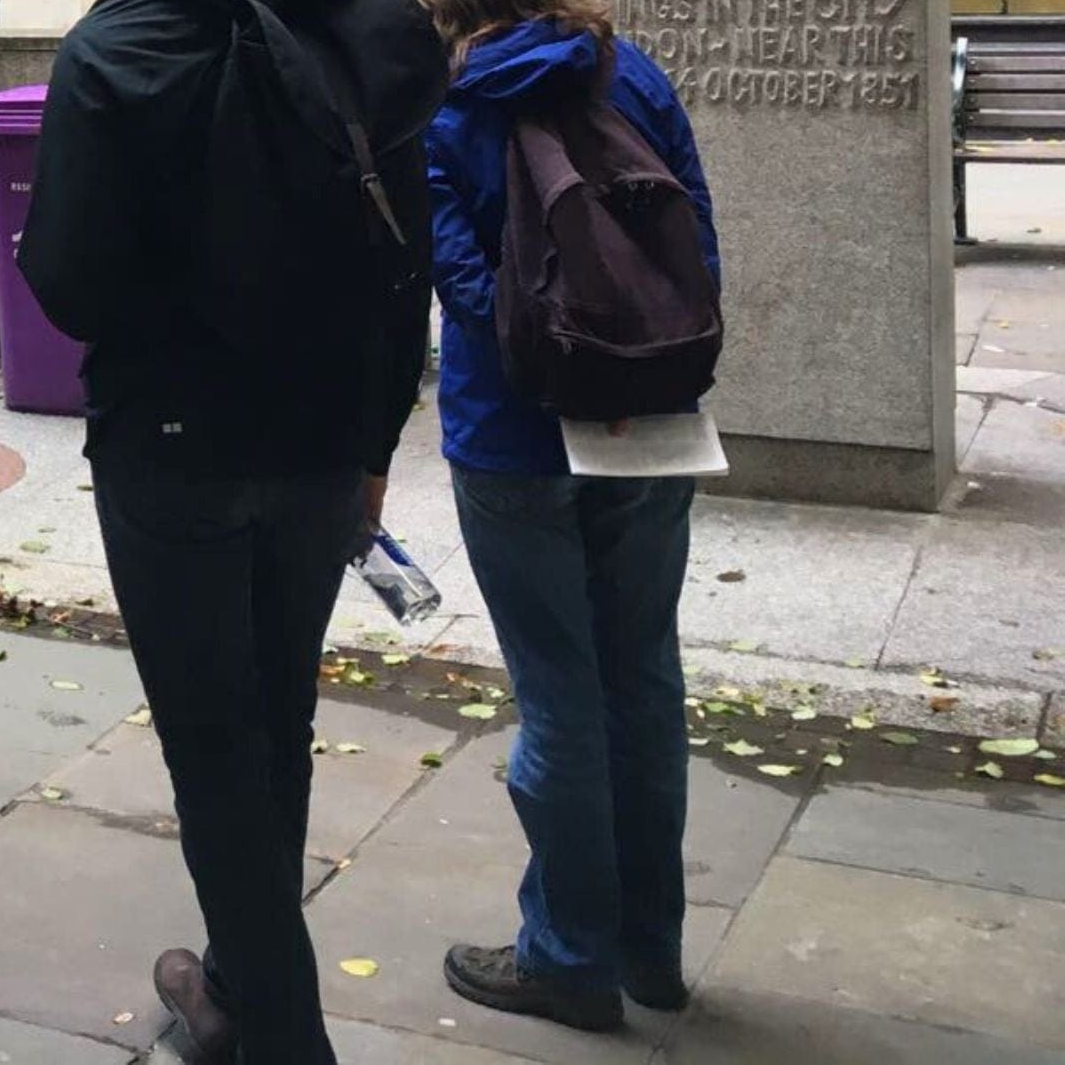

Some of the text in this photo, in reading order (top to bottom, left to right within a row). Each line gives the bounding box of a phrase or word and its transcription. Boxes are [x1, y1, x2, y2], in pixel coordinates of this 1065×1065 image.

[731, 24, 824, 63] NEAR
[831, 23, 907, 65] THIS
[704, 67, 836, 106] OCTOBER
[838, 71, 919, 109] 1851
